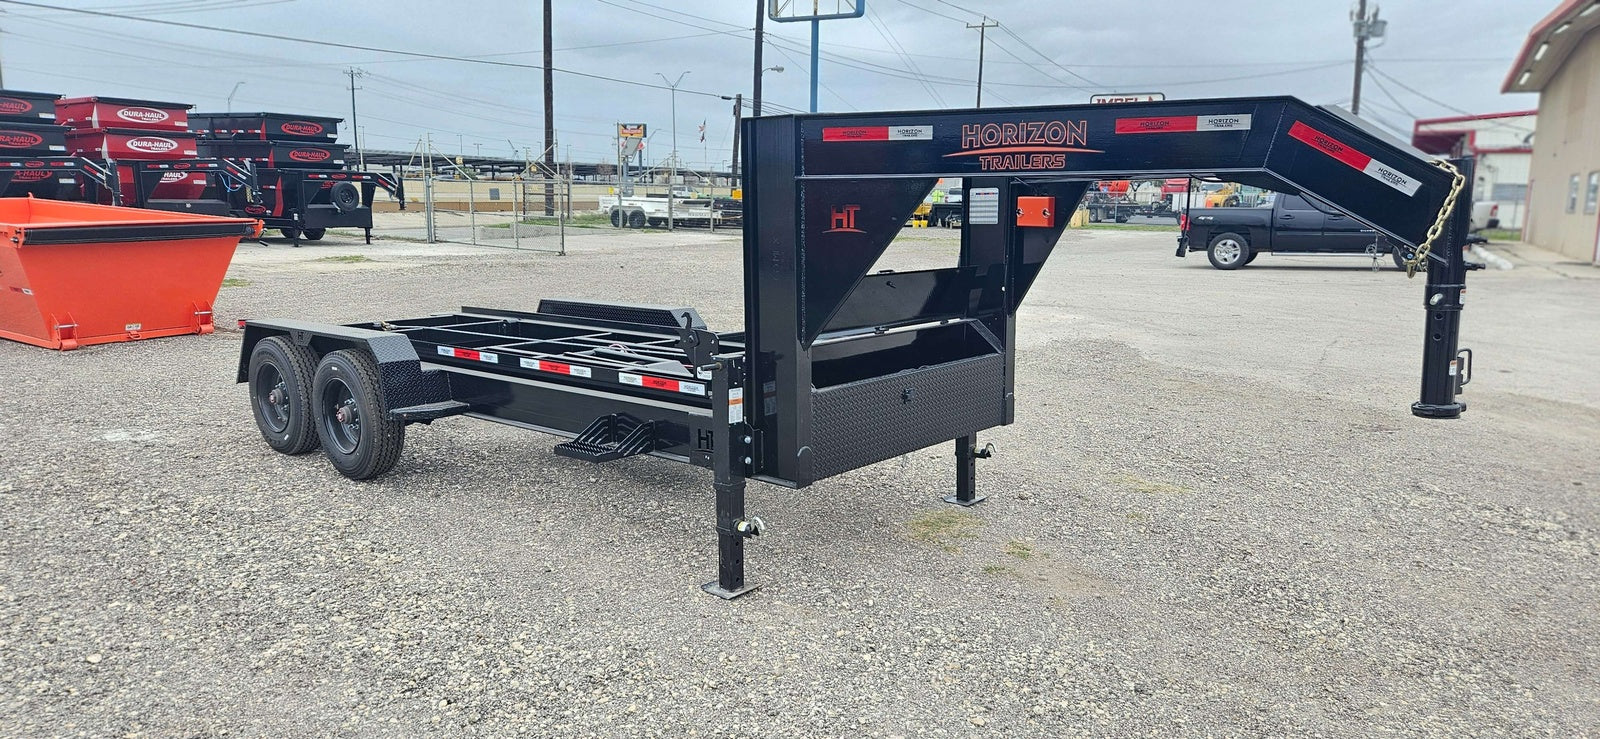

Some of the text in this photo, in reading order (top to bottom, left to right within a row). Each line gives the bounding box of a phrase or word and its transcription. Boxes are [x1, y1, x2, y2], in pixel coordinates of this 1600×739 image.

[123, 110, 163, 120] DURA-HAUL
[0, 135, 36, 143] RA-HAUL
[963, 121, 1088, 149] HORIZON
[132, 140, 173, 149] DURA-HAUL
[979, 153, 1066, 171] TRAILERS
[1378, 167, 1408, 185] HORIZON
[831, 204, 860, 229] HT
